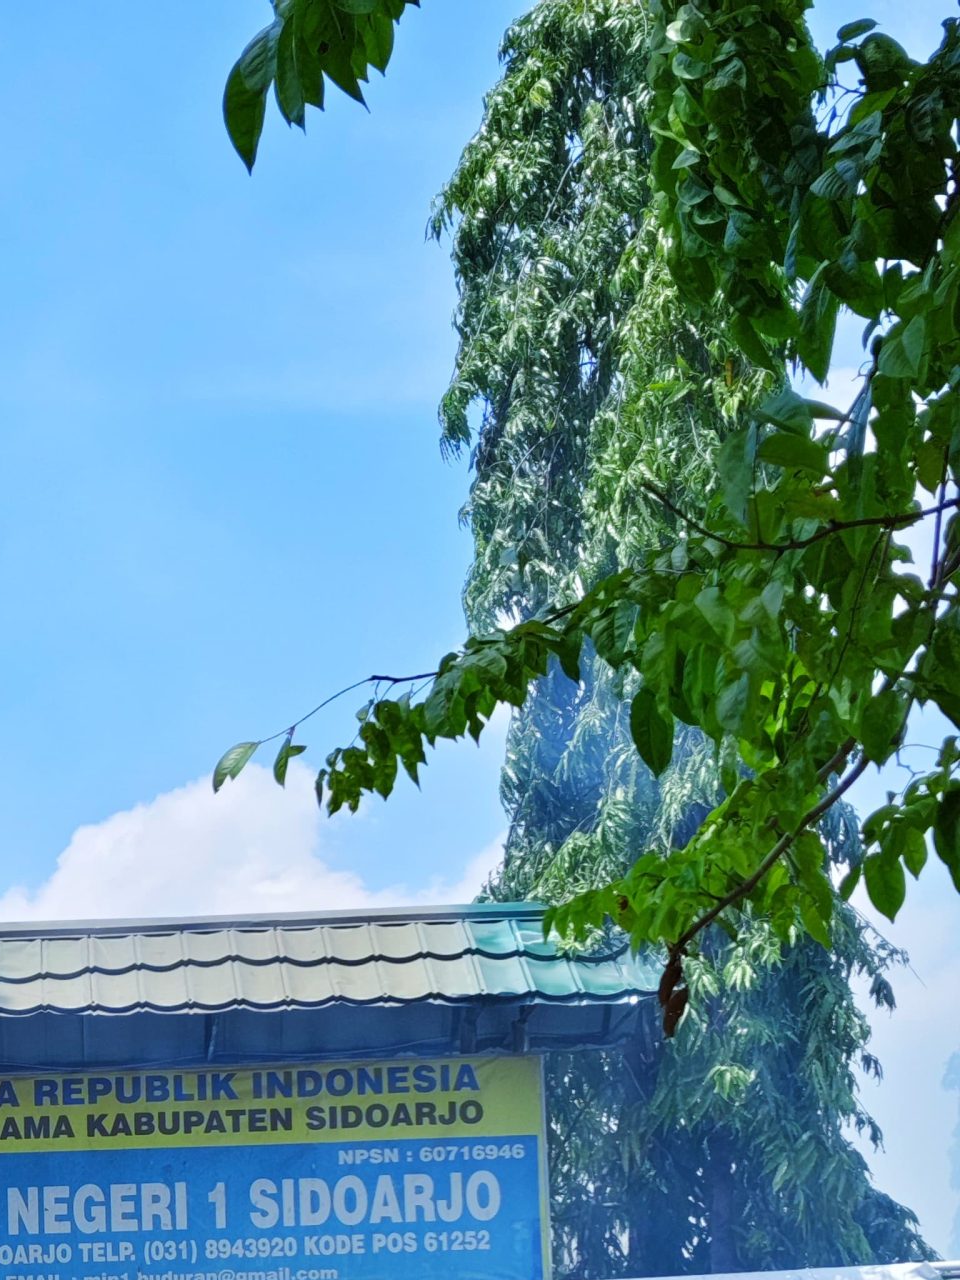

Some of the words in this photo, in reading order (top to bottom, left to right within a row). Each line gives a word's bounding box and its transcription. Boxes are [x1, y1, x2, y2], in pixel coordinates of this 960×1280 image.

[34, 1073, 238, 1107] REPUBLIK
[253, 1063, 479, 1099] INDONESIA
[86, 1107, 292, 1137] KABUPATEN
[306, 1100, 483, 1130] SIDOARJO
[338, 1148, 399, 1165] NPSN
[419, 1144, 525, 1162] 60716946
[7, 1181, 187, 1235] NEGERI
[208, 1182, 226, 1229] 1
[250, 1170, 500, 1229] SIDOARJO
[78, 1241, 136, 1263] TELP.
[144, 1240, 197, 1264] (031)
[205, 1237, 297, 1259] 8943920
[304, 1234, 365, 1256] KODE
[372, 1232, 418, 1253] POS
[424, 1230, 490, 1251] 61252
